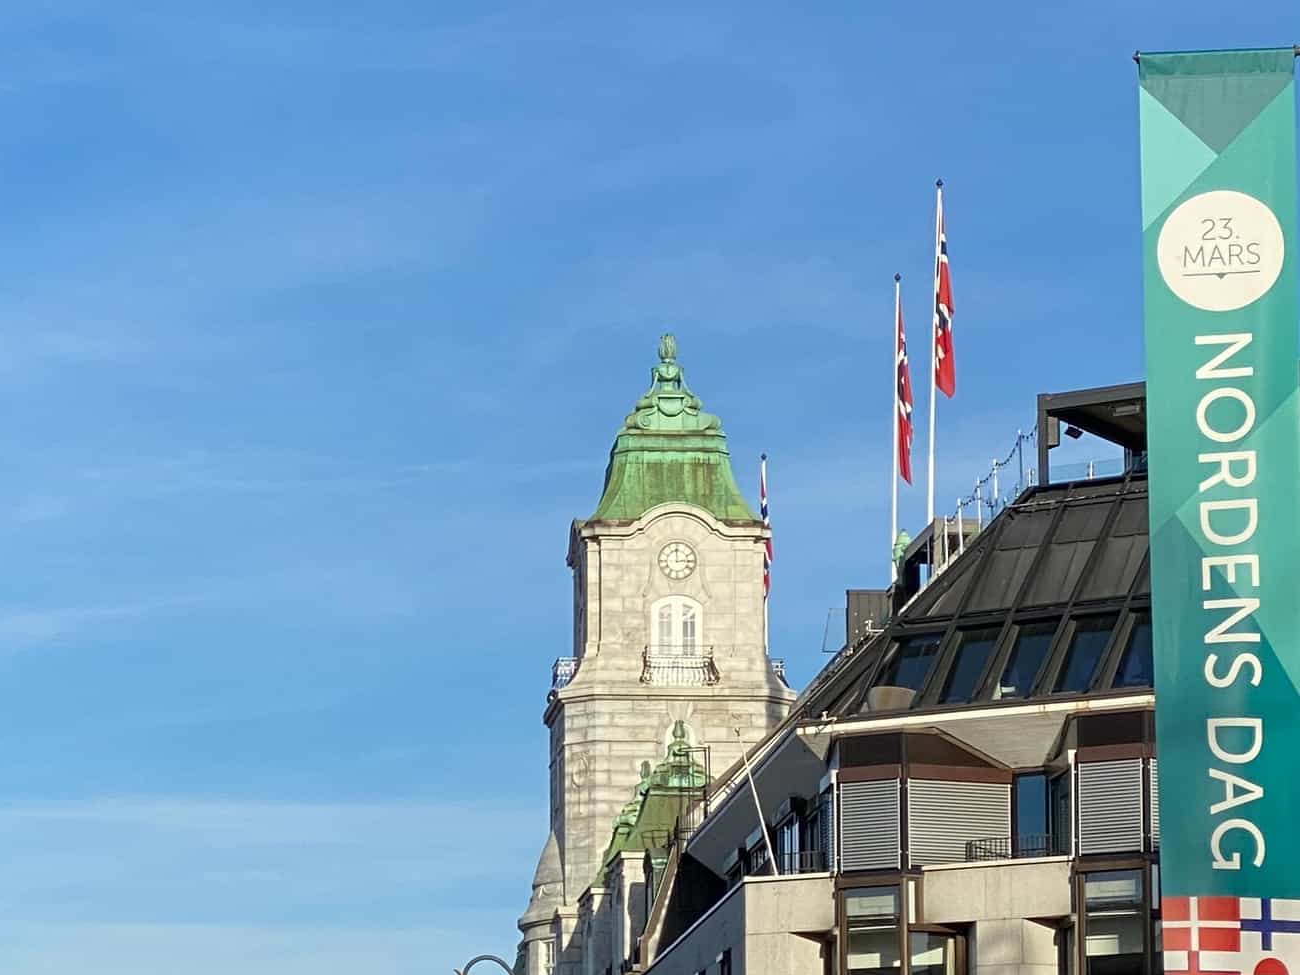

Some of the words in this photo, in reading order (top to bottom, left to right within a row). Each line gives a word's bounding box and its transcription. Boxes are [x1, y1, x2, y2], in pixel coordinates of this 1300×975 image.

[1183, 241, 1261, 268] MARS
[1201, 217, 1240, 240] 23.
[1194, 332, 1262, 690] NORDENS
[1206, 717, 1266, 870] DAG
